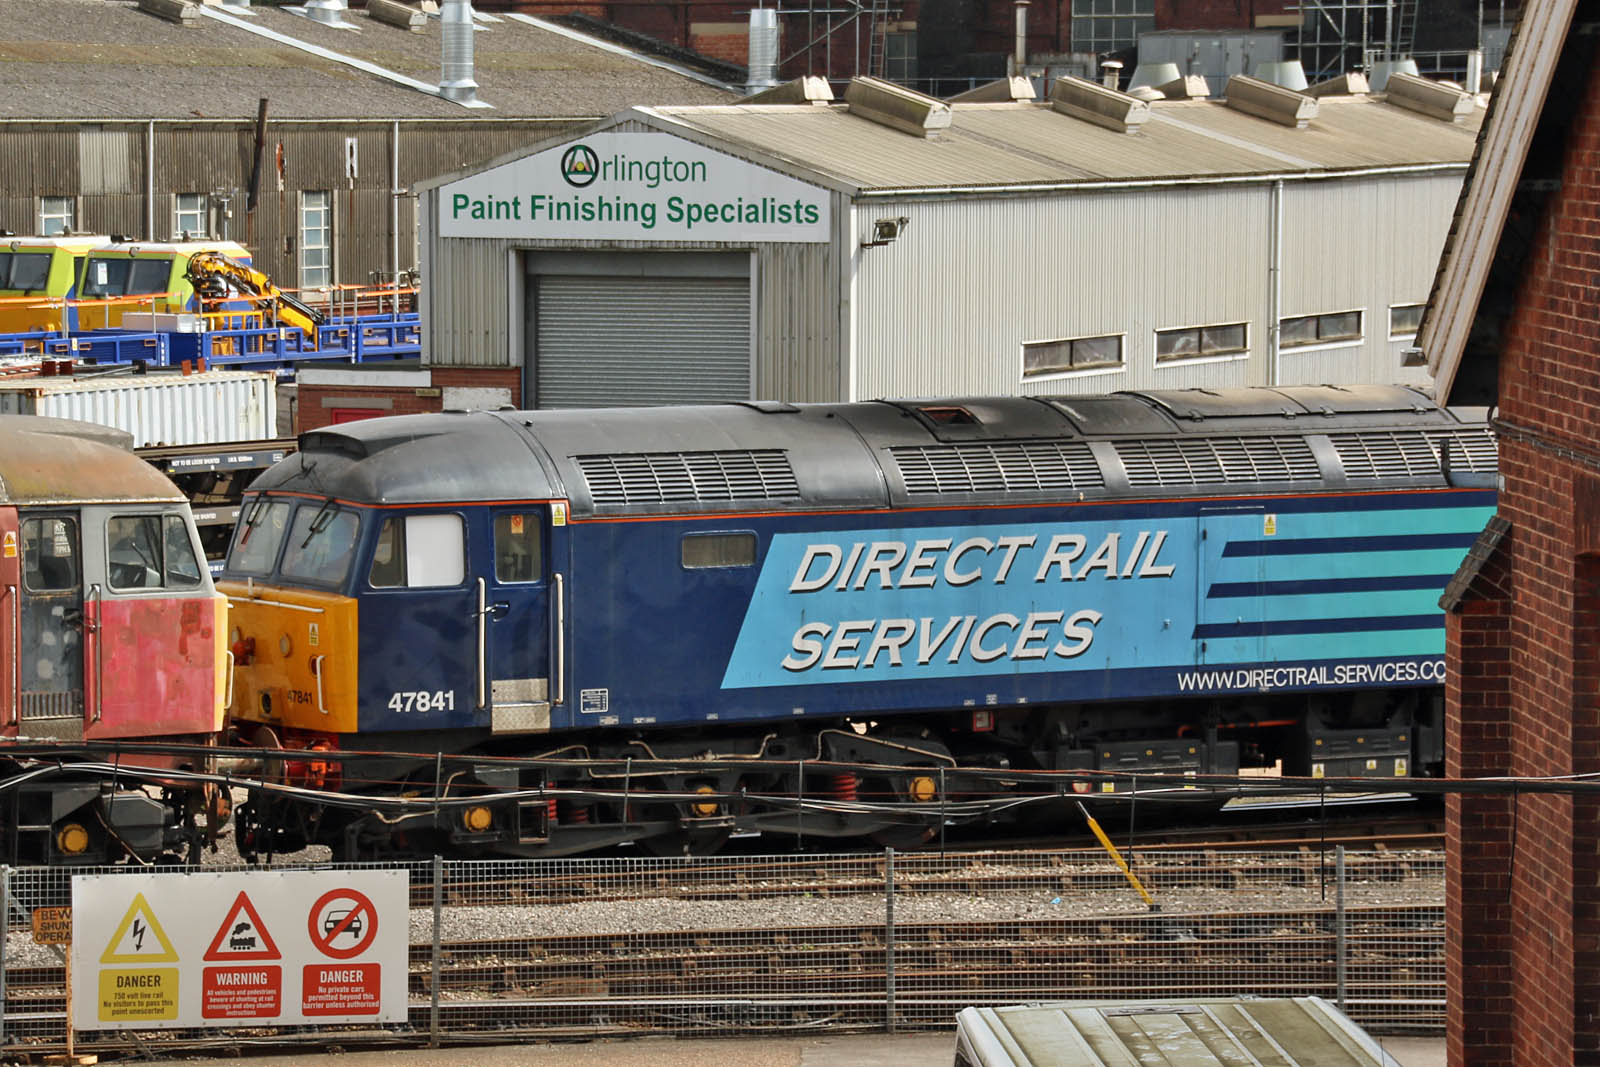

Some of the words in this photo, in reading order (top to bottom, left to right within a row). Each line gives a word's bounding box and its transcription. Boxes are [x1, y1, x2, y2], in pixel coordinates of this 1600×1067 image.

[453, 194, 521, 220] Paint
[531, 195, 656, 229] Finishing
[667, 196, 819, 229] Specialists
[788, 534, 1038, 594] DIRECT
[1034, 530, 1176, 582] RAIL
[781, 609, 1102, 672] SERVICES
[388, 690, 455, 713] 47841
[116, 975, 161, 988] DANGER
[216, 971, 268, 986] WARNING
[320, 970, 363, 983] DANGER
[114, 992, 126, 1000] 750
[127, 991, 139, 1000] volt
[140, 991, 152, 999] live
[152, 991, 164, 999] rail
[308, 994, 338, 1002] permitted
[339, 993, 362, 1001] beyond
[325, 1001, 345, 1009] unless
